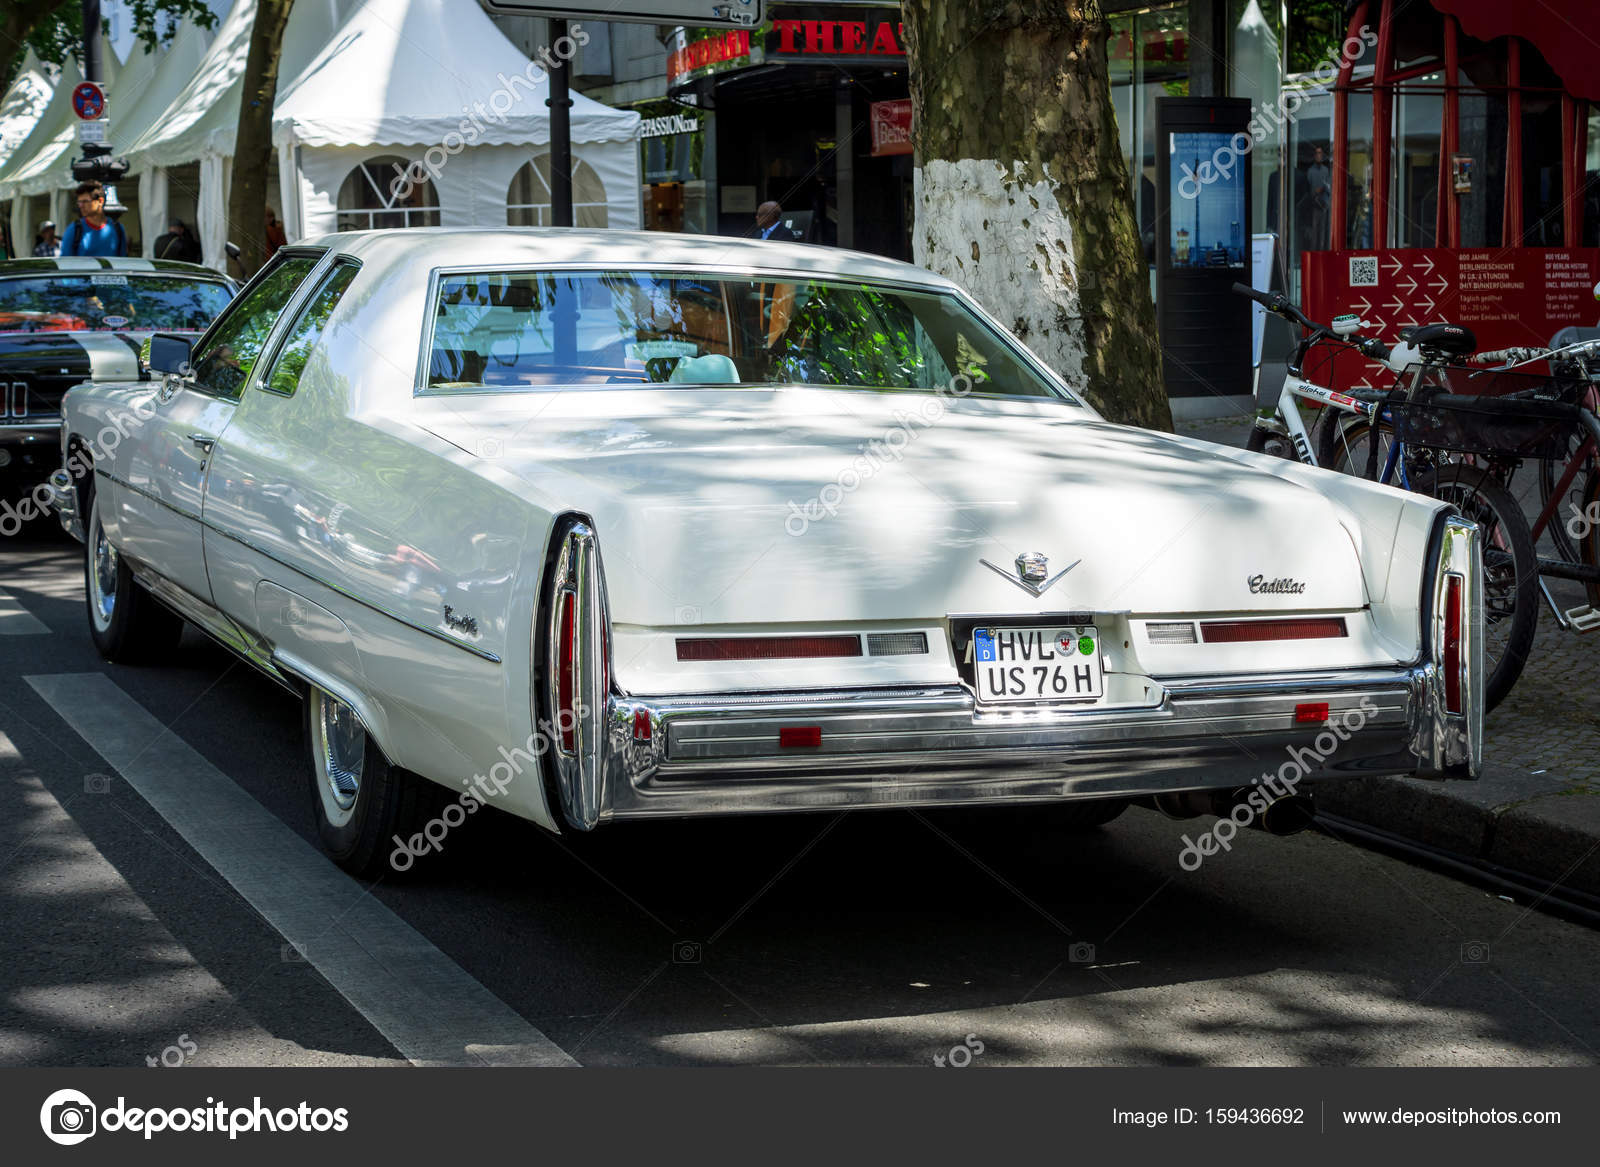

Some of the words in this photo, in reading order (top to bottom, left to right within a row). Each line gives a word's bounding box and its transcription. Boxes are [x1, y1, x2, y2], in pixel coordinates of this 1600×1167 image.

[773, 19, 908, 55] THEA
[1483, 272, 1510, 280] STUNDEN
[1247, 574, 1305, 595] Cadillac
[982, 650, 991, 660] D
[998, 631, 1055, 661] HVL
